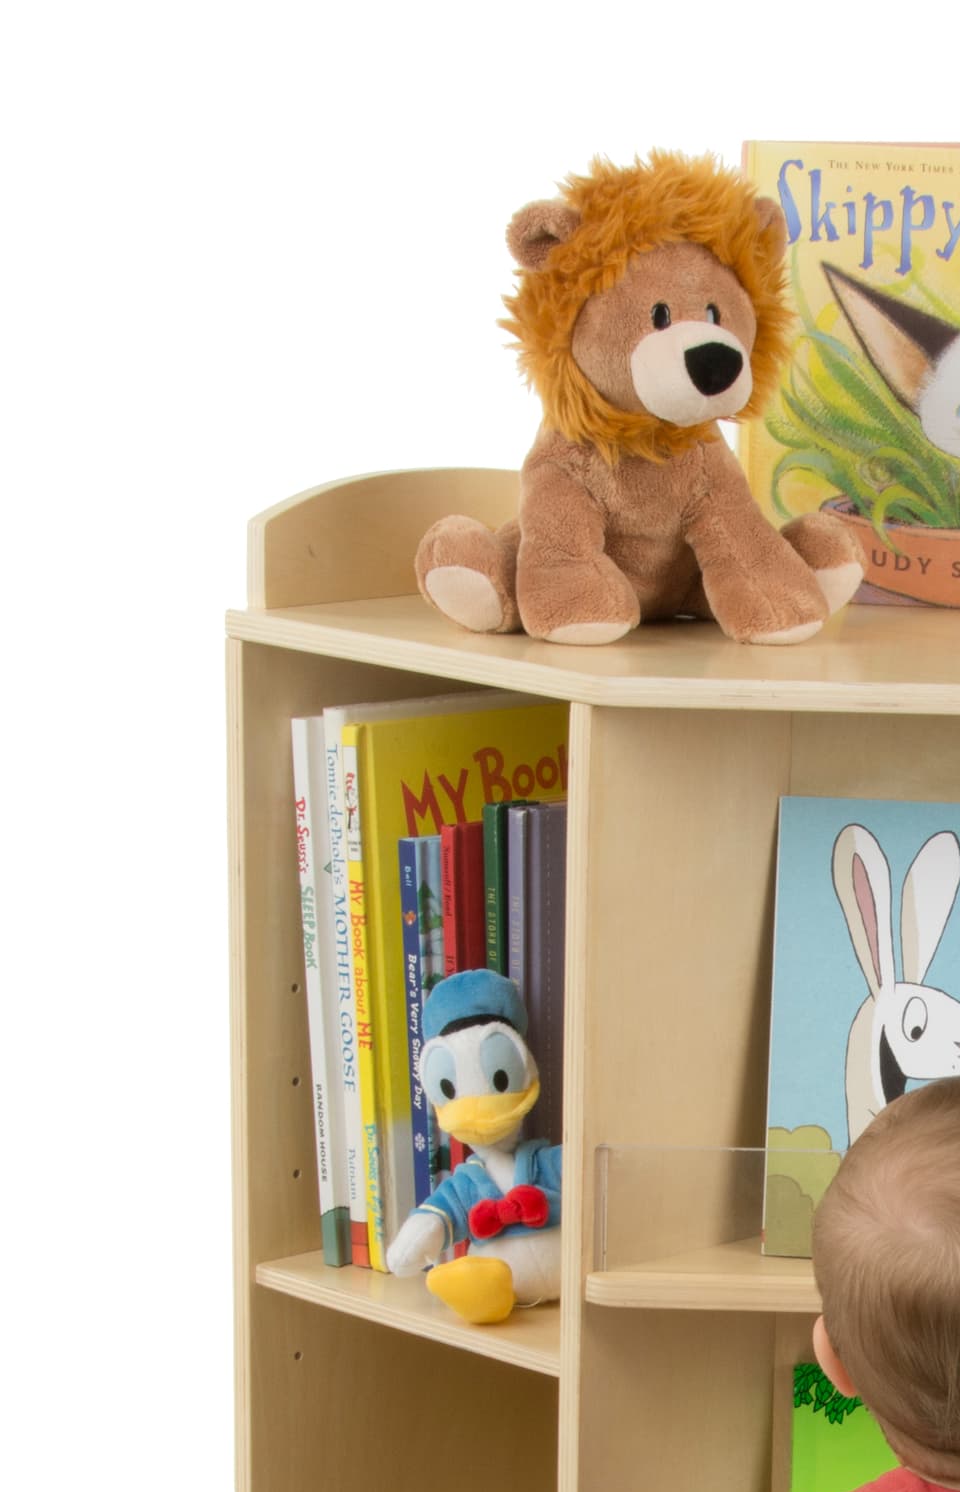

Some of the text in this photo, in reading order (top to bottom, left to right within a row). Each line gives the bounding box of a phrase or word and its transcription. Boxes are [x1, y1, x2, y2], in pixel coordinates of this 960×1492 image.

[871, 549, 932, 576] UDY
[297, 826, 310, 874] Seuss's
[302, 886, 315, 930] SLEEP
[488, 887, 497, 905] THE
[333, 894, 352, 1003] MOTHER
[488, 911, 497, 945] STORY
[354, 967, 369, 1015] about
[340, 1011, 356, 1093] GOOSE
[357, 1022, 374, 1051] ME
[408, 953, 423, 1110] Bear's Very Snowy Day
[316, 1083, 328, 1182] RANDOM HOUSE
